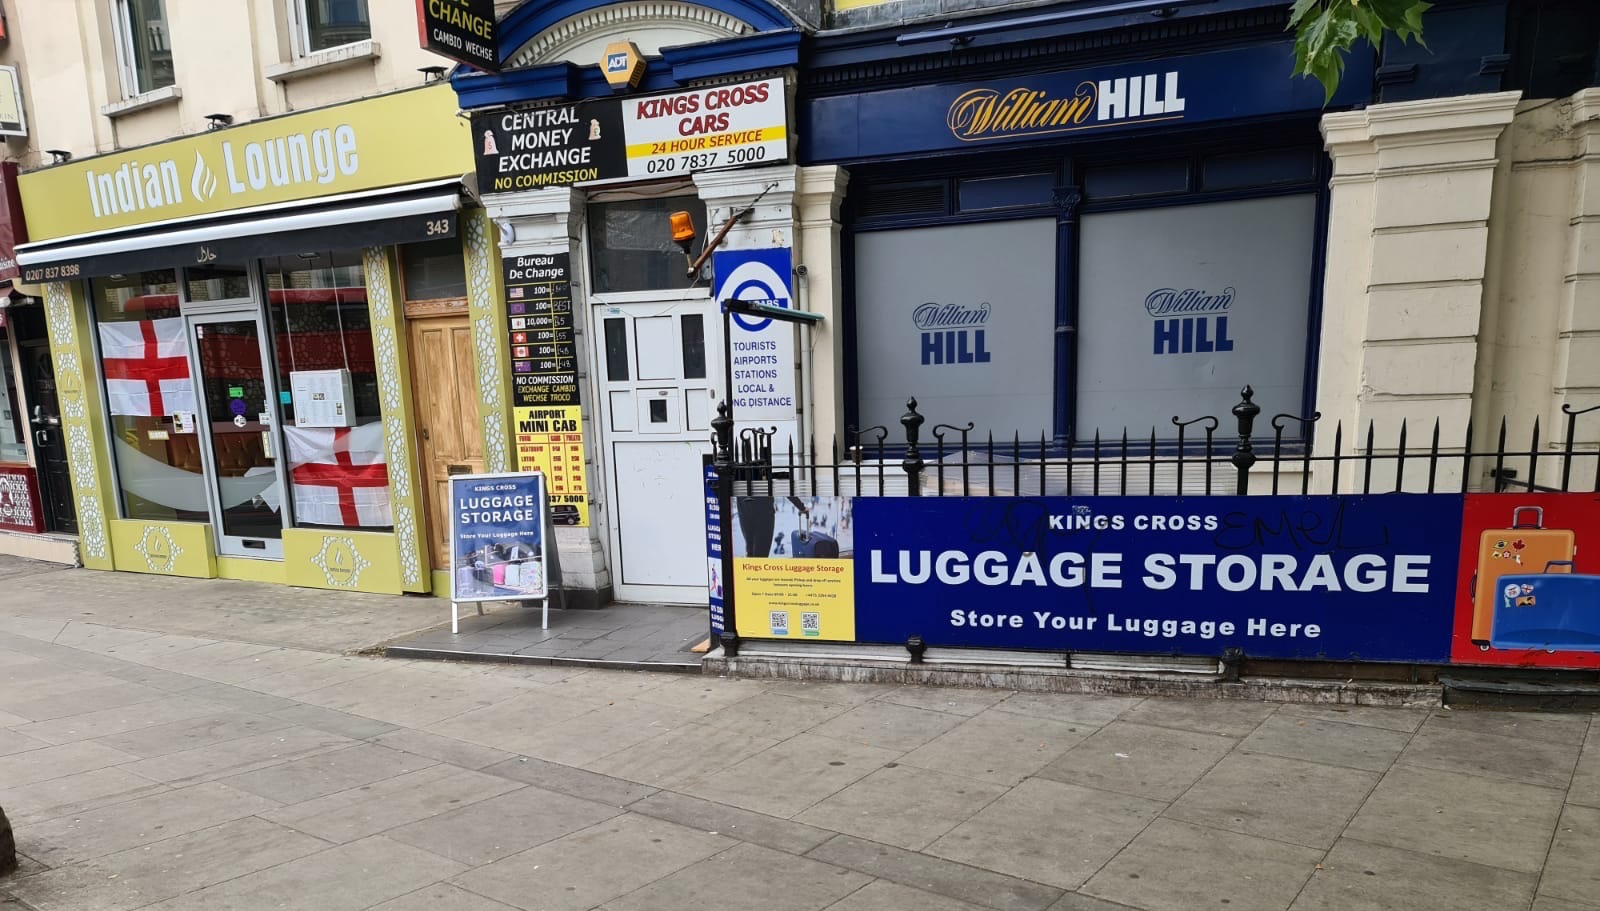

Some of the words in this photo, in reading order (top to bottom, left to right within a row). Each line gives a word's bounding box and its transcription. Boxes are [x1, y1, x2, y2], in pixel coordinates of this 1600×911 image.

[429, 0, 492, 40] CHANGE
[433, 28, 462, 49] CAMBIO
[465, 40, 493, 61] WECHSE
[608, 55, 627, 69] ADT
[637, 94, 700, 119] KINGS
[705, 83, 769, 110] CROSS
[947, 81, 1098, 141] William
[1098, 71, 1185, 120] HILL
[502, 107, 579, 131] CENTRAL
[679, 113, 729, 136] CARS
[512, 128, 573, 151] MONEY
[652, 142, 666, 154] 24
[671, 138, 705, 152] HOUR
[710, 130, 762, 147] SERVICE
[498, 147, 591, 172] EXCHANGE
[647, 158, 675, 173] 020
[681, 152, 718, 170] 7837
[727, 146, 765, 164] 5000
[87, 159, 182, 217] Indian
[223, 124, 358, 194] Lounge
[495, 177, 512, 189] NO
[516, 168, 598, 187] COMMISSION
[426, 219, 449, 236] 343
[517, 257, 554, 267] Bureau
[26, 269, 43, 281] 0207
[45, 267, 59, 279] 837
[509, 269, 523, 279] De
[525, 268, 564, 279] Change
[1145, 287, 1236, 317] William
[912, 302, 991, 331] William
[1153, 316, 1234, 355] HILL
[733, 341, 776, 351] TOURISTS
[921, 330, 991, 365] HILL
[734, 355, 777, 365] AIRPORTS
[516, 376, 526, 385] NO
[528, 375, 573, 385] COMMISSION
[734, 370, 777, 379] STATIONS
[738, 384, 766, 393] LOCAL
[768, 383, 774, 392] &
[749, 397, 792, 408] DISTANCE
[528, 410, 565, 420] AIRPORT
[520, 421, 549, 432] MINI
[553, 420, 577, 432] CAB
[460, 495, 534, 510] LUGGAGE
[564, 495, 584, 503] 5000
[461, 509, 533, 524] STORAGE
[1049, 515, 1125, 531] KINGS
[1134, 515, 1218, 531] CROSS
[742, 563, 762, 572] Kings
[763, 563, 783, 571] Cross
[785, 564, 815, 573] Luggage
[816, 565, 844, 573] Storage
[871, 549, 1122, 588] LUGGAGE
[1142, 553, 1431, 593] STORAGE
[950, 609, 1024, 628] Store
[1033, 611, 1097, 630] Your
[1107, 613, 1235, 639] Luggage
[1247, 618, 1321, 638] Here
